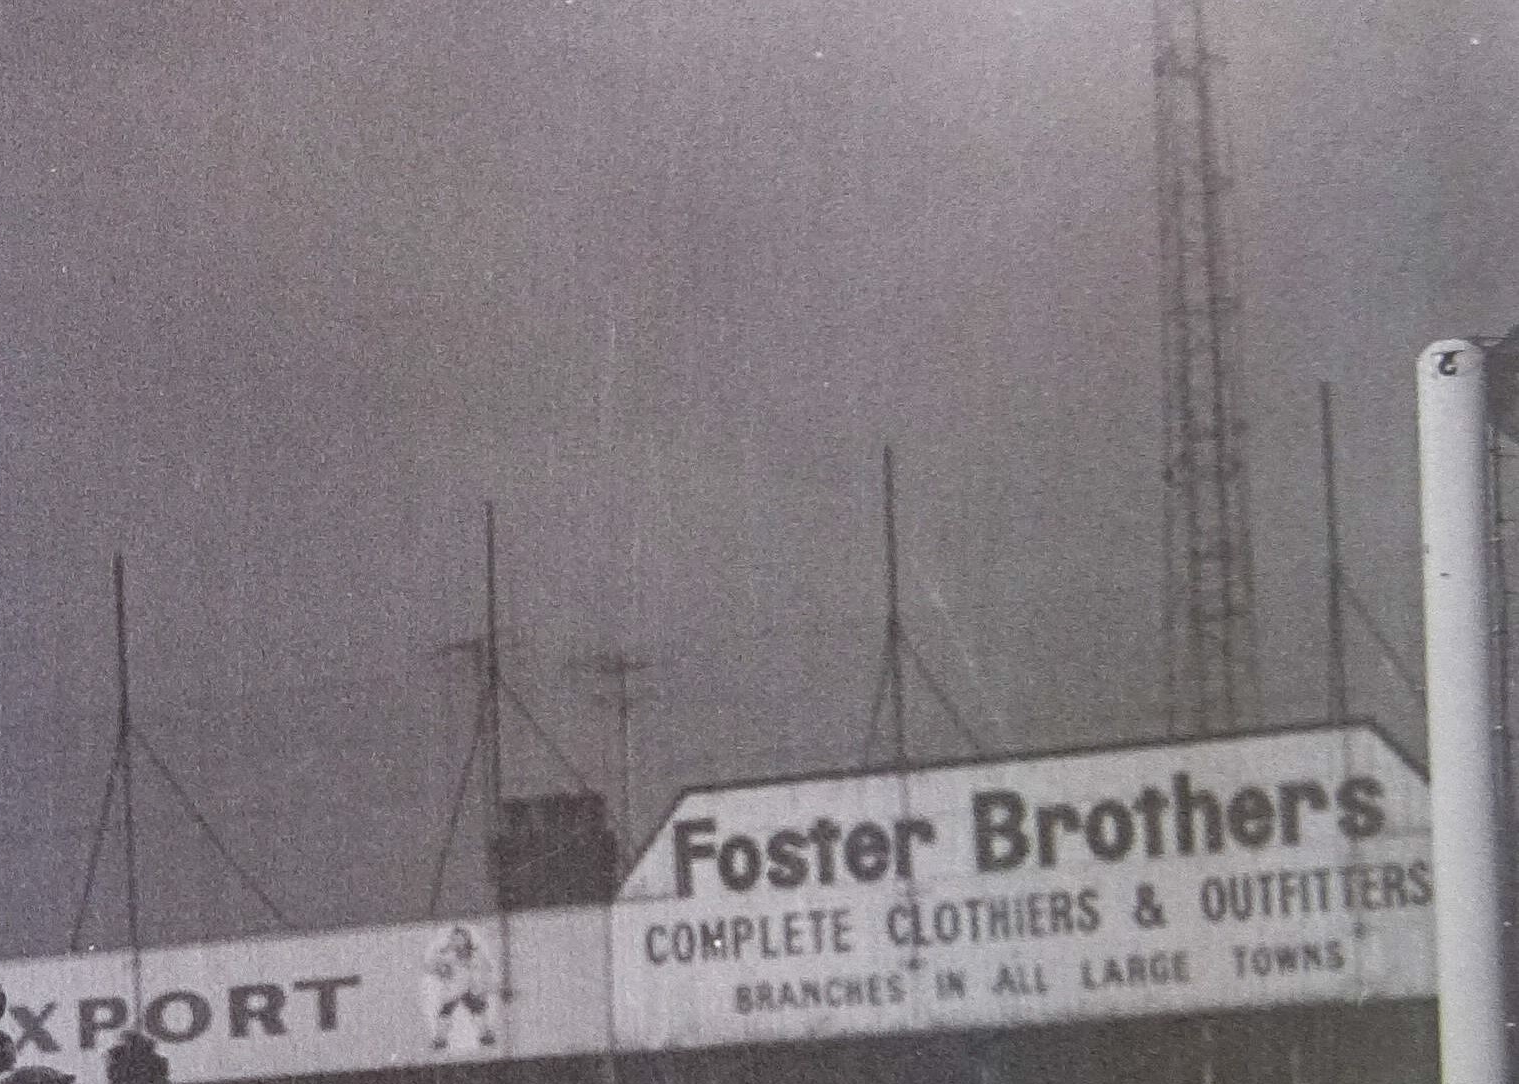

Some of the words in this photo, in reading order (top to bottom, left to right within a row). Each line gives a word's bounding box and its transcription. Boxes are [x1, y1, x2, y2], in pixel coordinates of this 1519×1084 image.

[674, 817, 937, 899] Foster
[973, 771, 1386, 872] Brothers
[645, 907, 853, 966] COMPLETE
[885, 887, 1101, 948] CLOTHIERS
[1133, 881, 1167, 929] &
[1200, 859, 1434, 922] OUTFITTERS
[8, 973, 362, 1053] XPORT
[734, 970, 907, 1015] BRANCHES
[935, 967, 967, 999] IN
[992, 958, 1047, 997] ALL
[1082, 949, 1191, 991] LARGE
[1231, 938, 1347, 979] TOWNS
